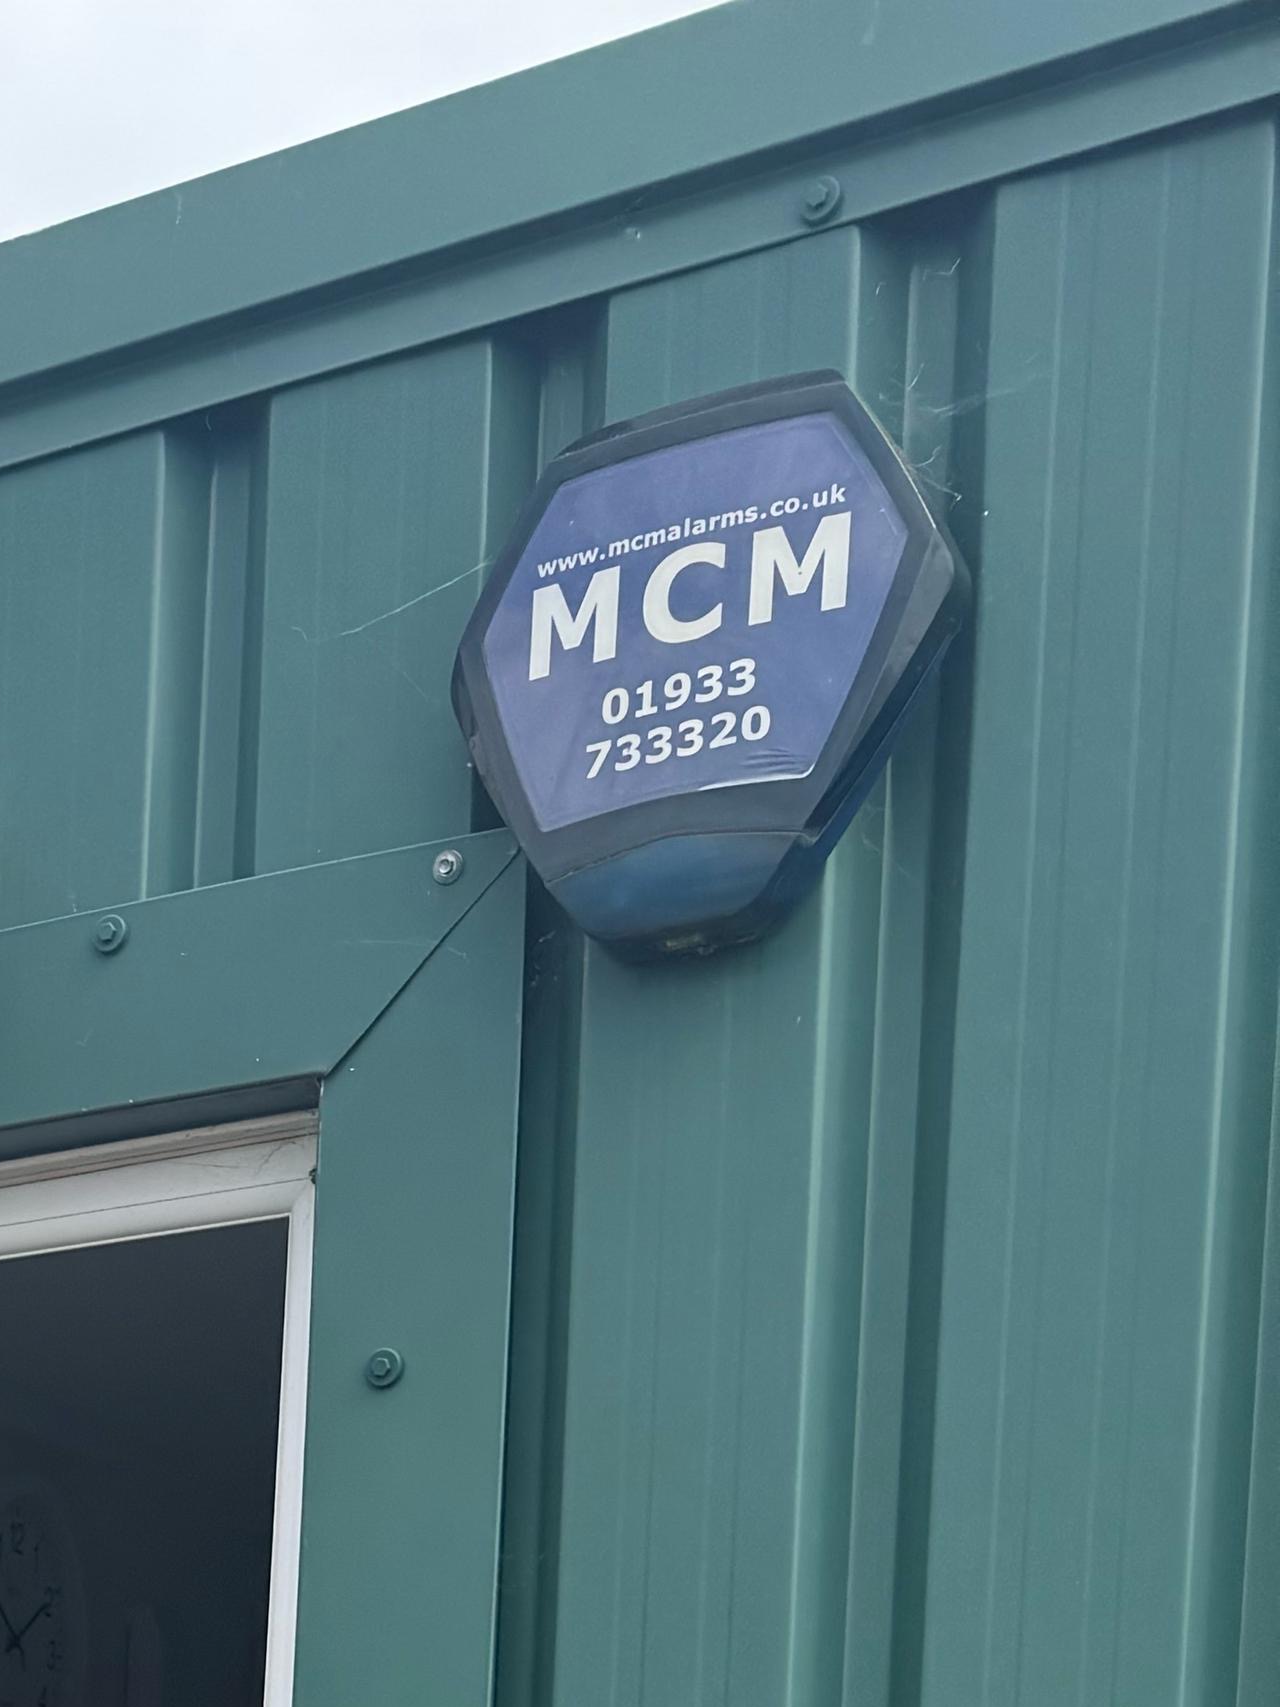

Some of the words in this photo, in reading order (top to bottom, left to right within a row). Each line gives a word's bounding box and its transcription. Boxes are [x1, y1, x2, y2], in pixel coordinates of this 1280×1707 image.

[537, 483, 845, 577] www.mcmalarms.co.uk
[528, 511, 851, 680] MCM
[601, 658, 757, 724] 01933
[585, 705, 771, 779] 733320
